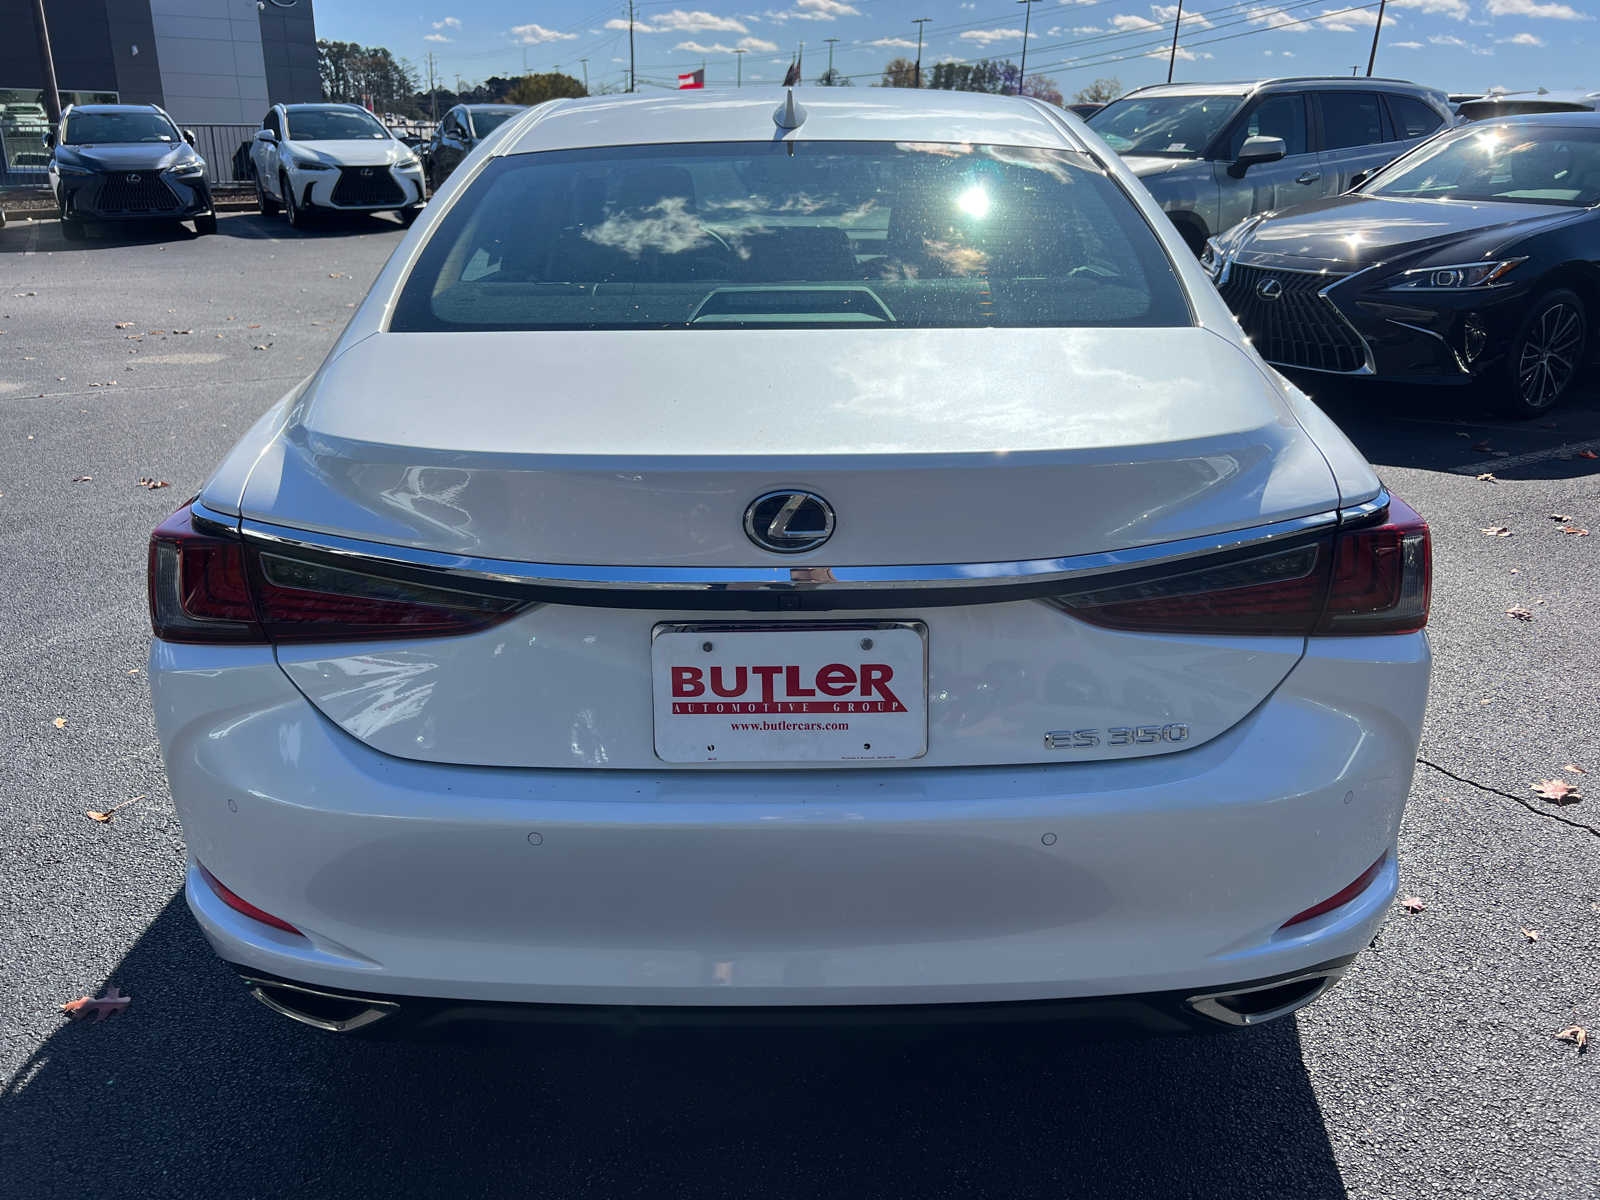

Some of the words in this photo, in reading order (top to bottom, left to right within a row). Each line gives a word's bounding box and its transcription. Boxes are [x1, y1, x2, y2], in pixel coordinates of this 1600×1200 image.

[673, 702, 809, 713] AUTOMOTIVE
[833, 701, 899, 712] GROUP
[730, 720, 849, 731] www.butlercars.com
[1044, 728, 1100, 750] ES
[1107, 722, 1189, 747] 350
